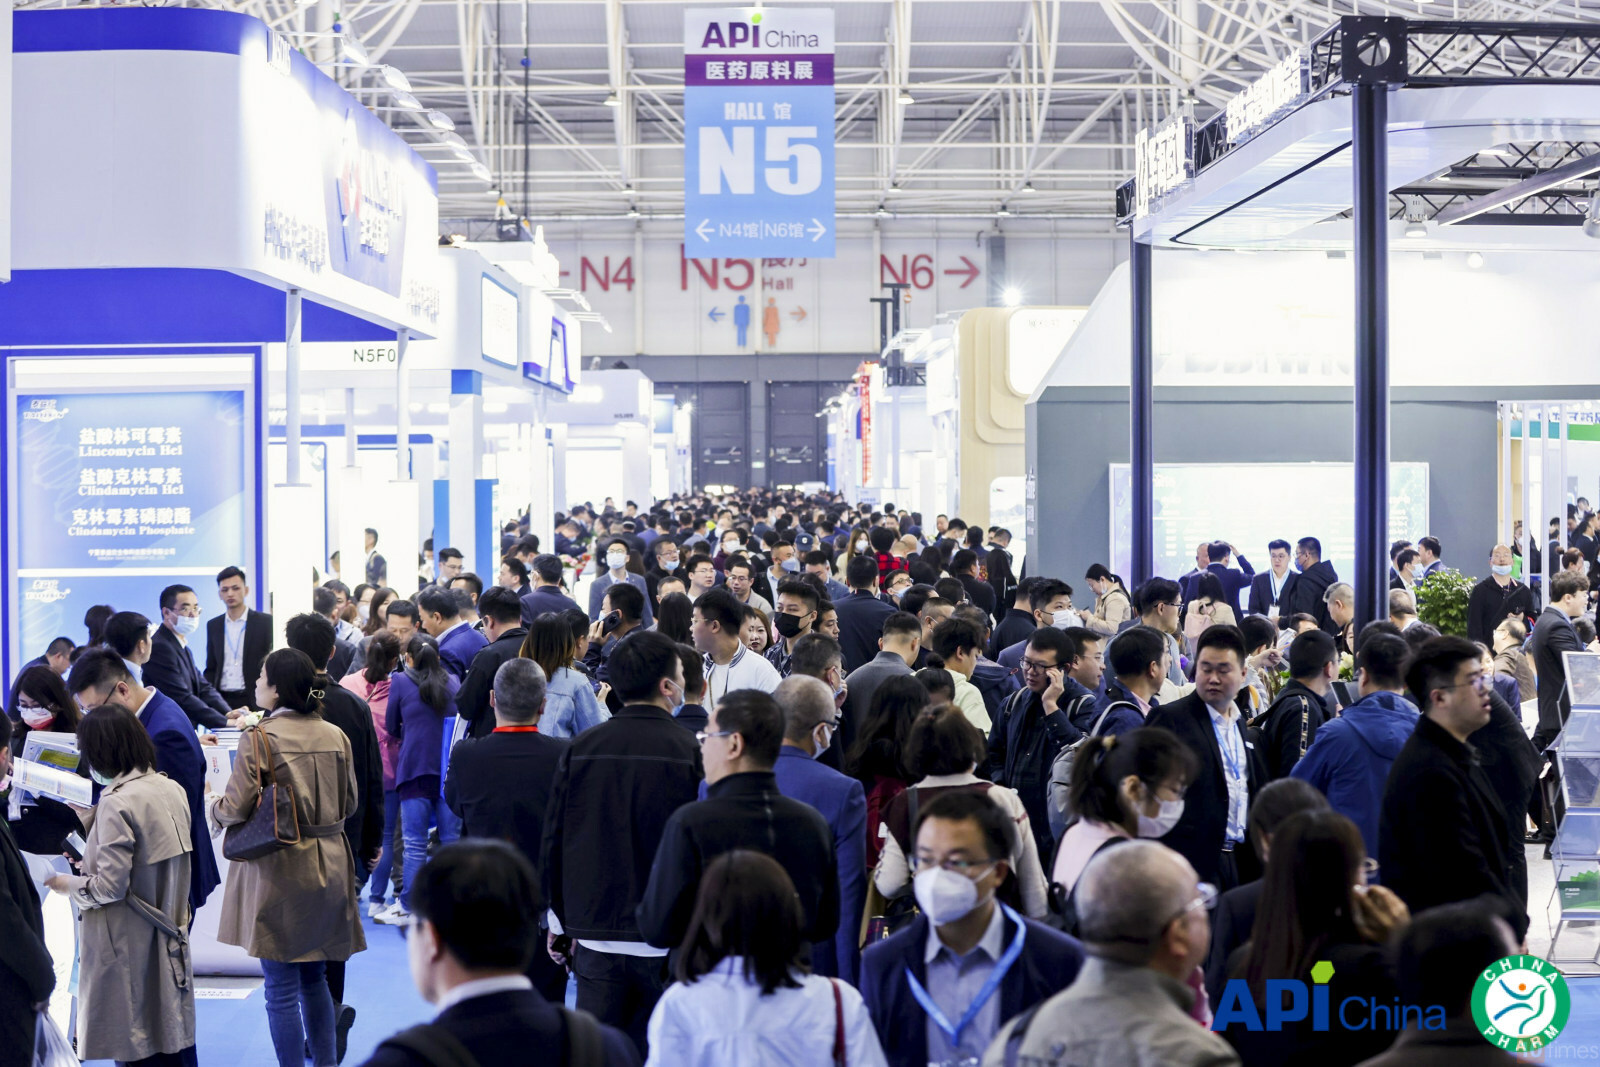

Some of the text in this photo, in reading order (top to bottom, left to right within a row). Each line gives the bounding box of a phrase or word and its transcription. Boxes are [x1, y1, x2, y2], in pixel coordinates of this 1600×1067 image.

[765, 30, 819, 48] China
[705, 60, 814, 80] 医药原料展
[724, 102, 792, 120] HALL 馆
[699, 126, 822, 195] N5
[580, 256, 635, 292] N4
[680, 243, 755, 291] N5
[880, 254, 934, 290] N6
[762, 277, 793, 290] Hall
[79, 426, 183, 445] 盐酸林可霉素
[78, 445, 156, 458] Lincomycin
[79, 467, 182, 485] 盐酸克林霉素
[78, 485, 158, 497] Clindamycin
[71, 507, 191, 526] 克林霉素磷酸酯
[67, 526, 196, 537] Clindamycin Phosphate
